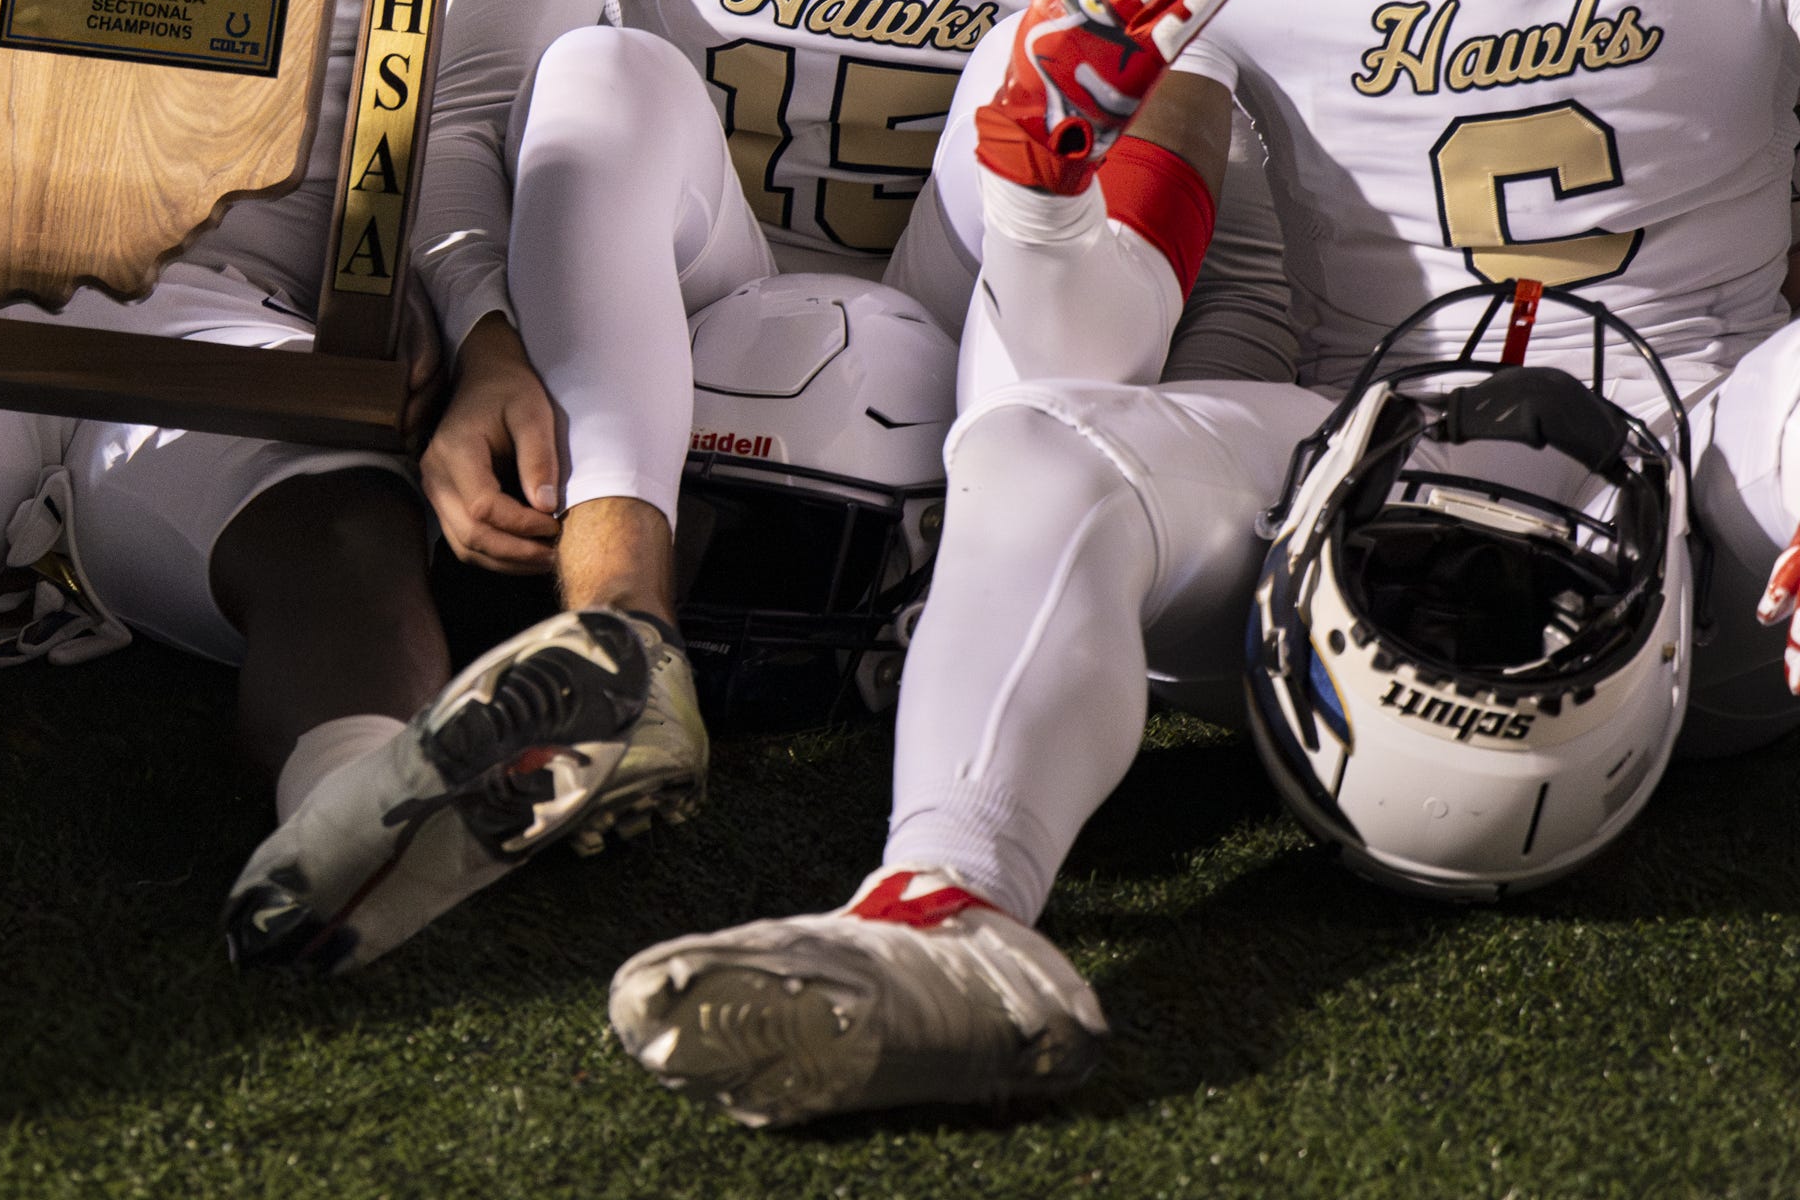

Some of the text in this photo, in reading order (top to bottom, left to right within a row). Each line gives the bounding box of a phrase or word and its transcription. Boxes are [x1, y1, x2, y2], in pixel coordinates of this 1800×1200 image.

[85, 13, 193, 41] CHAMPIONS
[209, 37, 261, 56] COLTS
[706, 37, 964, 254] 15
[690, 432, 773, 458] iddell
[1379, 680, 1536, 741] schutt
